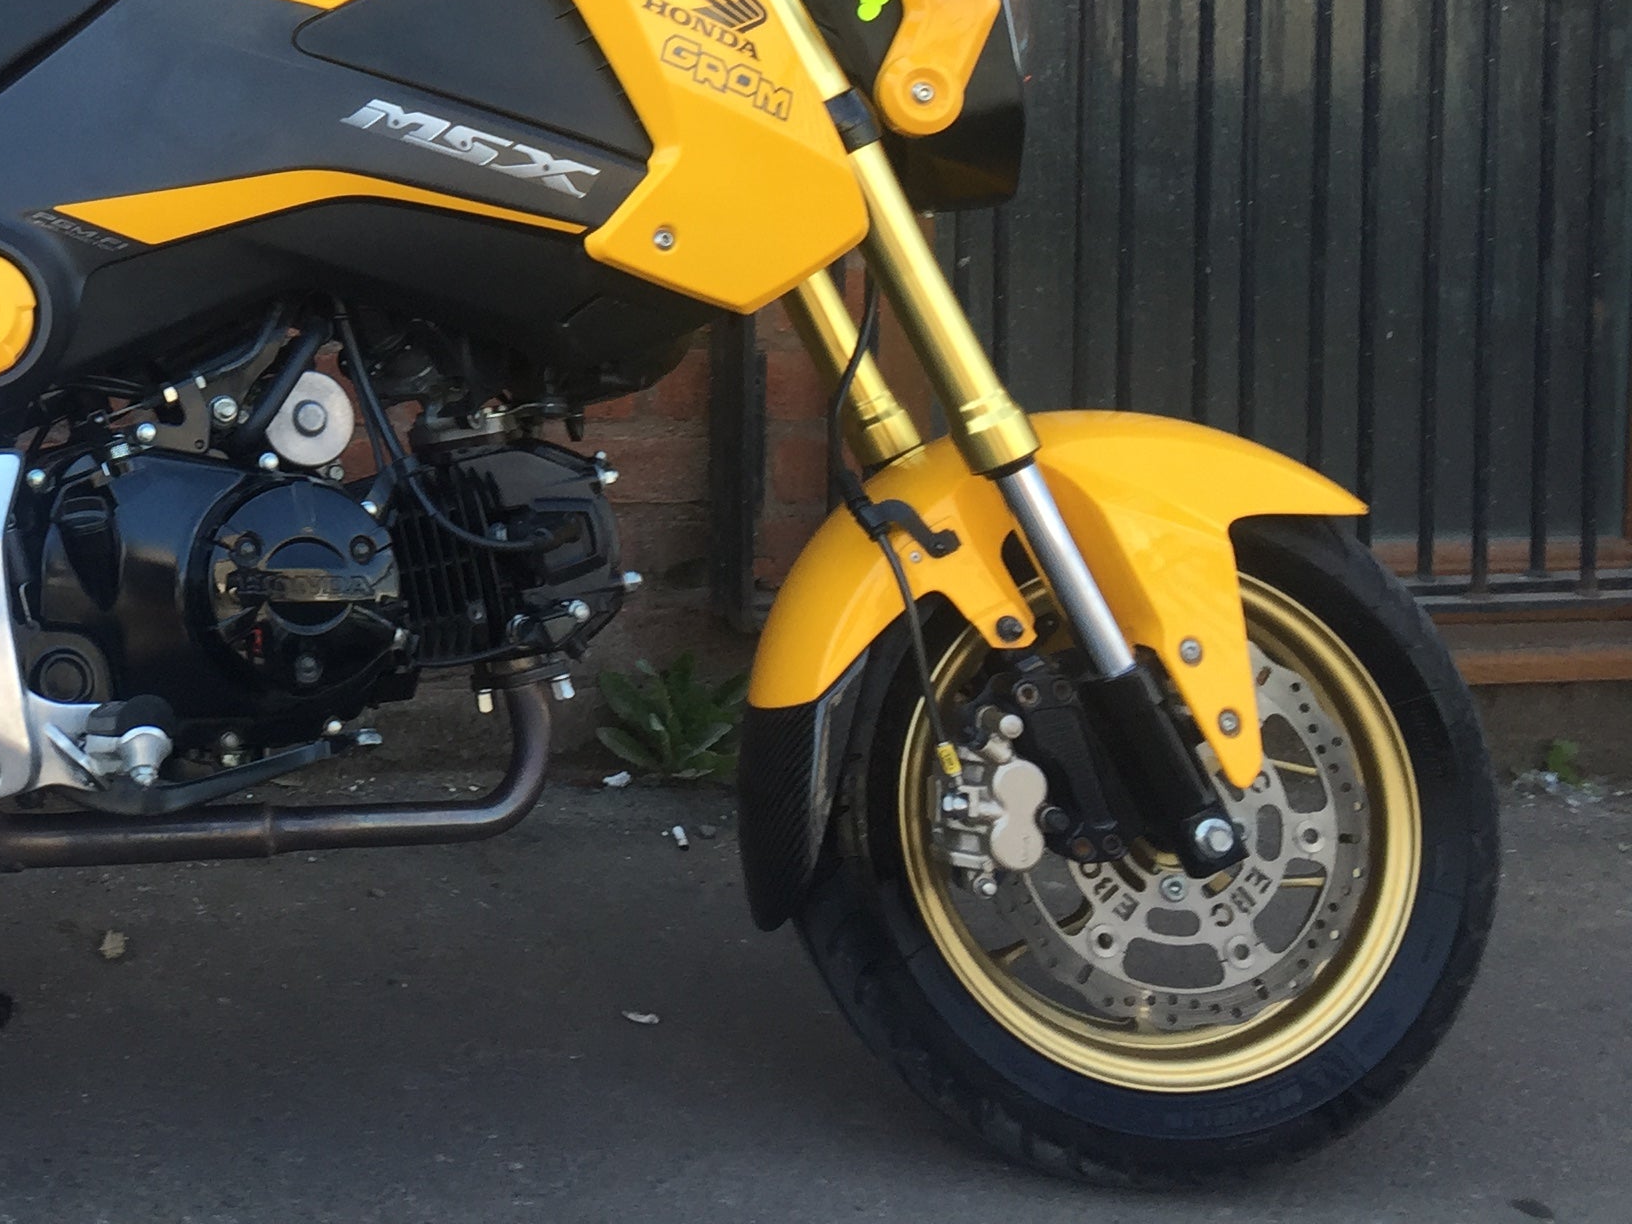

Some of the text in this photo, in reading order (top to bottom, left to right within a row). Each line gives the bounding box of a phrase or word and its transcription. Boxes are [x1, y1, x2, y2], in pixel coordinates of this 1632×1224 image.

[660, 34, 794, 122] GROM
[339, 98, 601, 199] MSX
[1209, 865, 1274, 928] EBC
